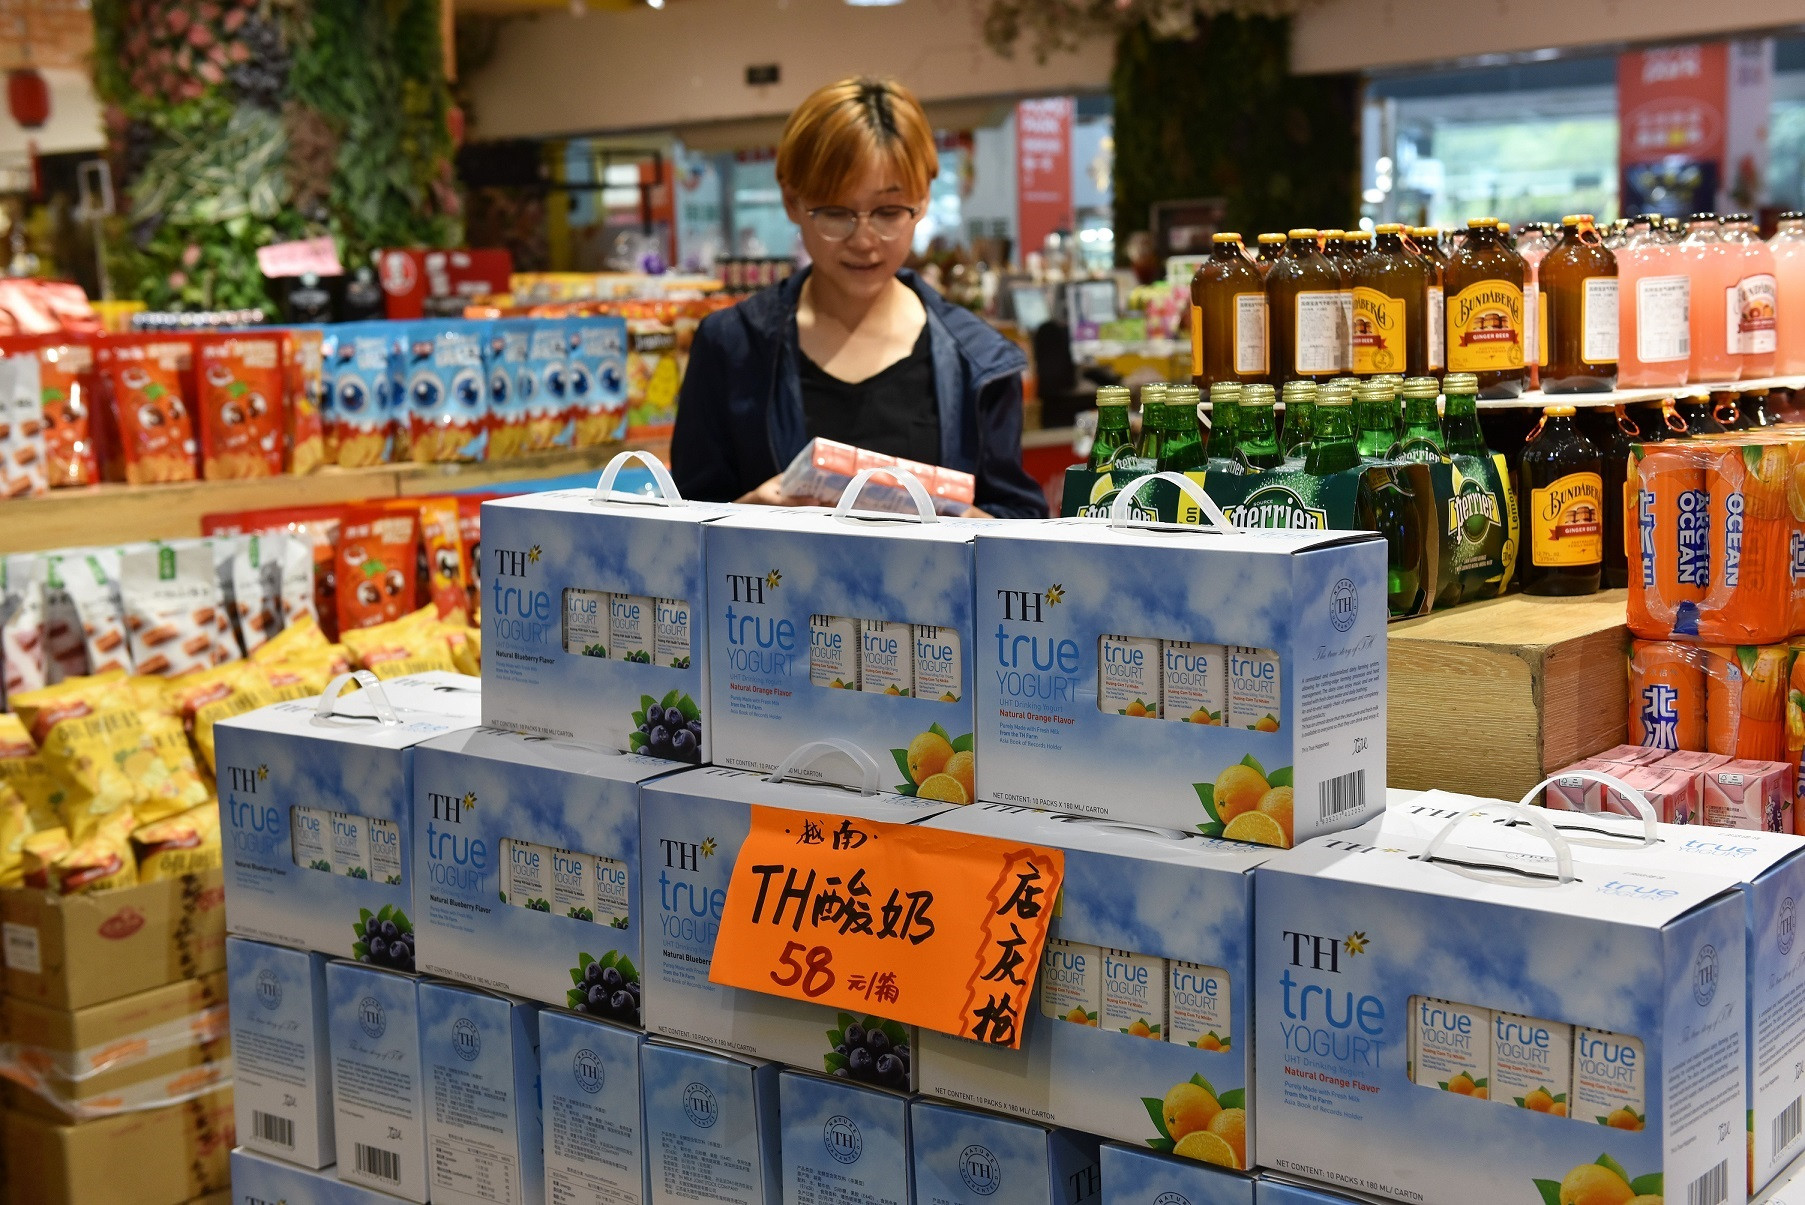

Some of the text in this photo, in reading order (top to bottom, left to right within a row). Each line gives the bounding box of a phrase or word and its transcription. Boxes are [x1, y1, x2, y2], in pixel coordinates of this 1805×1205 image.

[1454, 290, 1520, 328] BUNDABERG
[1678, 491, 1696, 583] OCEAN
[1695, 489, 1710, 588] ARCTIC
[1726, 493, 1745, 587] OCEAN
[495, 549, 527, 577] TH
[493, 578, 550, 621] true
[726, 574, 765, 604] TH
[569, 594, 596, 614] true
[612, 599, 640, 619] true
[657, 604, 687, 625] true
[998, 590, 1044, 622] TH
[1337, 597, 1351, 613] TH
[569, 613, 596, 625] YOGURT
[611, 618, 640, 631] YOGURT
[657, 622, 687, 636] YOGURT
[726, 605, 795, 651] true
[494, 617, 551, 644] YOGURT
[810, 627, 842, 648] true
[810, 646, 842, 660] YOGURT
[864, 632, 897, 654] true
[917, 639, 952, 661] true
[995, 624, 1080, 674] true
[1104, 642, 1143, 665] true
[496, 650, 555, 664] Natural Blueberry Flavor
[726, 648, 796, 676] YOGURT
[864, 652, 898, 666] YOGURT
[917, 659, 953, 674] YOGURT
[1166, 649, 1207, 673] true
[1231, 655, 1274, 679] true
[1104, 663, 1143, 679] YOGURT
[1166, 672, 1207, 686] YOGURT
[730, 683, 792, 696] Natural Orange Flavor
[996, 671, 1080, 702] YOGURT
[1231, 678, 1274, 693] YOGURT
[999, 709, 1075, 725] Natural Orange Flavor
[1015, 700, 1042, 712] Drinking
[1042, 703, 1063, 713] Yogurt
[228, 766, 257, 793] TH
[229, 793, 280, 835] true
[428, 793, 461, 824] TH
[1005, 794, 1031, 803] CONTENT:
[1040, 799, 1058, 808] PACKS
[1086, 806, 1109, 814] CARTON
[1410, 805, 1460, 819] TH
[297, 813, 320, 831] true
[333, 819, 357, 838] true
[371, 825, 397, 846] true
[427, 822, 487, 869] true
[797, 819, 868, 851] 越南
[1322, 839, 1377, 853] TH
[1686, 839, 1757, 853] true
[512, 845, 540, 868] true
[553, 853, 582, 876] true
[660, 838, 699, 872] TH
[427, 861, 487, 893] YOGURT
[512, 864, 539, 879] YOGURT
[554, 873, 582, 887] YOGURT
[596, 862, 625, 885] true
[596, 882, 625, 896] YOGURT
[659, 870, 726, 921] true
[1604, 880, 1679, 896] true
[429, 894, 491, 914] Natural Blueberry Flavor
[751, 864, 936, 945] TH酸奶
[1045, 945, 1085, 973] true
[1283, 930, 1342, 974] TH
[770, 940, 836, 998] 58
[1044, 967, 1085, 986] YOGURT
[1105, 956, 1148, 984] true
[1700, 965, 1713, 986] TH
[1105, 979, 1148, 998] YOGURT
[1173, 968, 1217, 996] true
[1173, 991, 1217, 1010] YOGURT
[1279, 969, 1385, 1035] true
[364, 1011, 380, 1025] TH
[1421, 1002, 1471, 1034] true
[458, 1033, 474, 1047] TH
[1421, 1027, 1472, 1049] YOGURT
[1495, 1016, 1549, 1048] true
[1280, 1021, 1386, 1068] YOGURT
[1496, 1041, 1550, 1063] YOGURT
[1579, 1032, 1636, 1066] true
[580, 1063, 597, 1079] TH
[1284, 1053, 1365, 1079] UHT Drinking Yogurt
[1579, 1058, 1635, 1082] YOGURT
[1284, 1066, 1380, 1094] Natural Orange Flavor
[1284, 1081, 1301, 1092] Purely
[1302, 1084, 1317, 1094] Made
[1319, 1088, 1330, 1097] with
[1332, 1091, 1347, 1100] Fresh
[691, 1097, 710, 1113] TH
[1284, 1089, 1298, 1098] from
[1317, 1097, 1332, 1105] Farm
[1284, 1098, 1296, 1106] Asia
[1296, 1101, 1311, 1110] Book
[1319, 1105, 1342, 1117] Records
[1344, 1111, 1364, 1121] Holder
[829, 1118, 858, 1133] NATURE
[832, 1130, 853, 1149] TH
[964, 1147, 995, 1164] NATURE
[969, 1161, 991, 1179] TH
[1276, 1159, 1290, 1168] NET
[1291, 1162, 1325, 1177] CONTENT:
[1326, 1171, 1334, 1179] 10
[1336, 1173, 1359, 1185] PACKS
[1366, 1180, 1378, 1190] 180
[1379, 1184, 1393, 1194] ML/
[1394, 1187, 1424, 1201] CARTON
